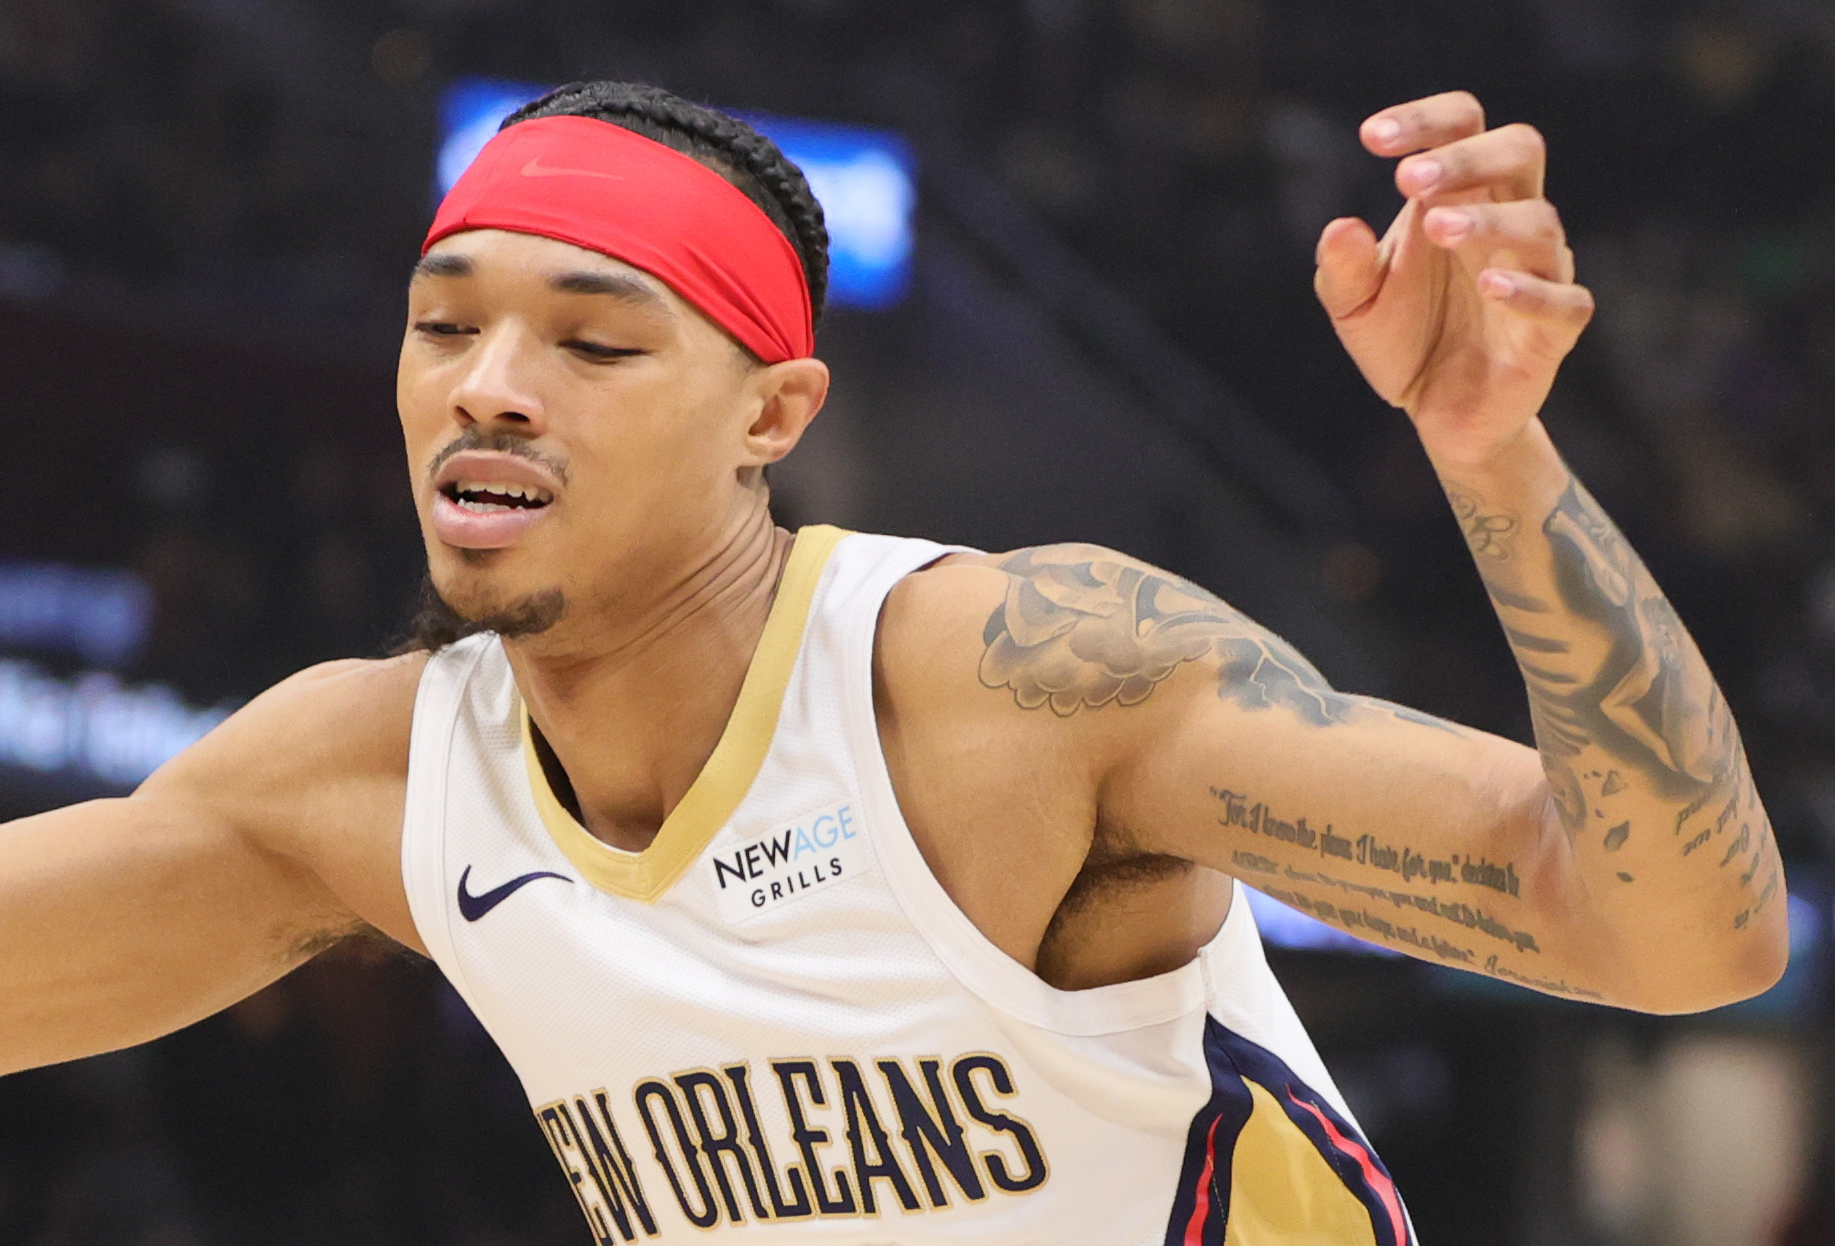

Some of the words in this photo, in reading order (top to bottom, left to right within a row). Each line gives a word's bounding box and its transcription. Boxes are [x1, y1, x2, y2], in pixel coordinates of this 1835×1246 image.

[712, 805, 856, 889] NEWAGE
[751, 857, 843, 907] GRILLS
[632, 1049, 1051, 1230] ORLEANS
